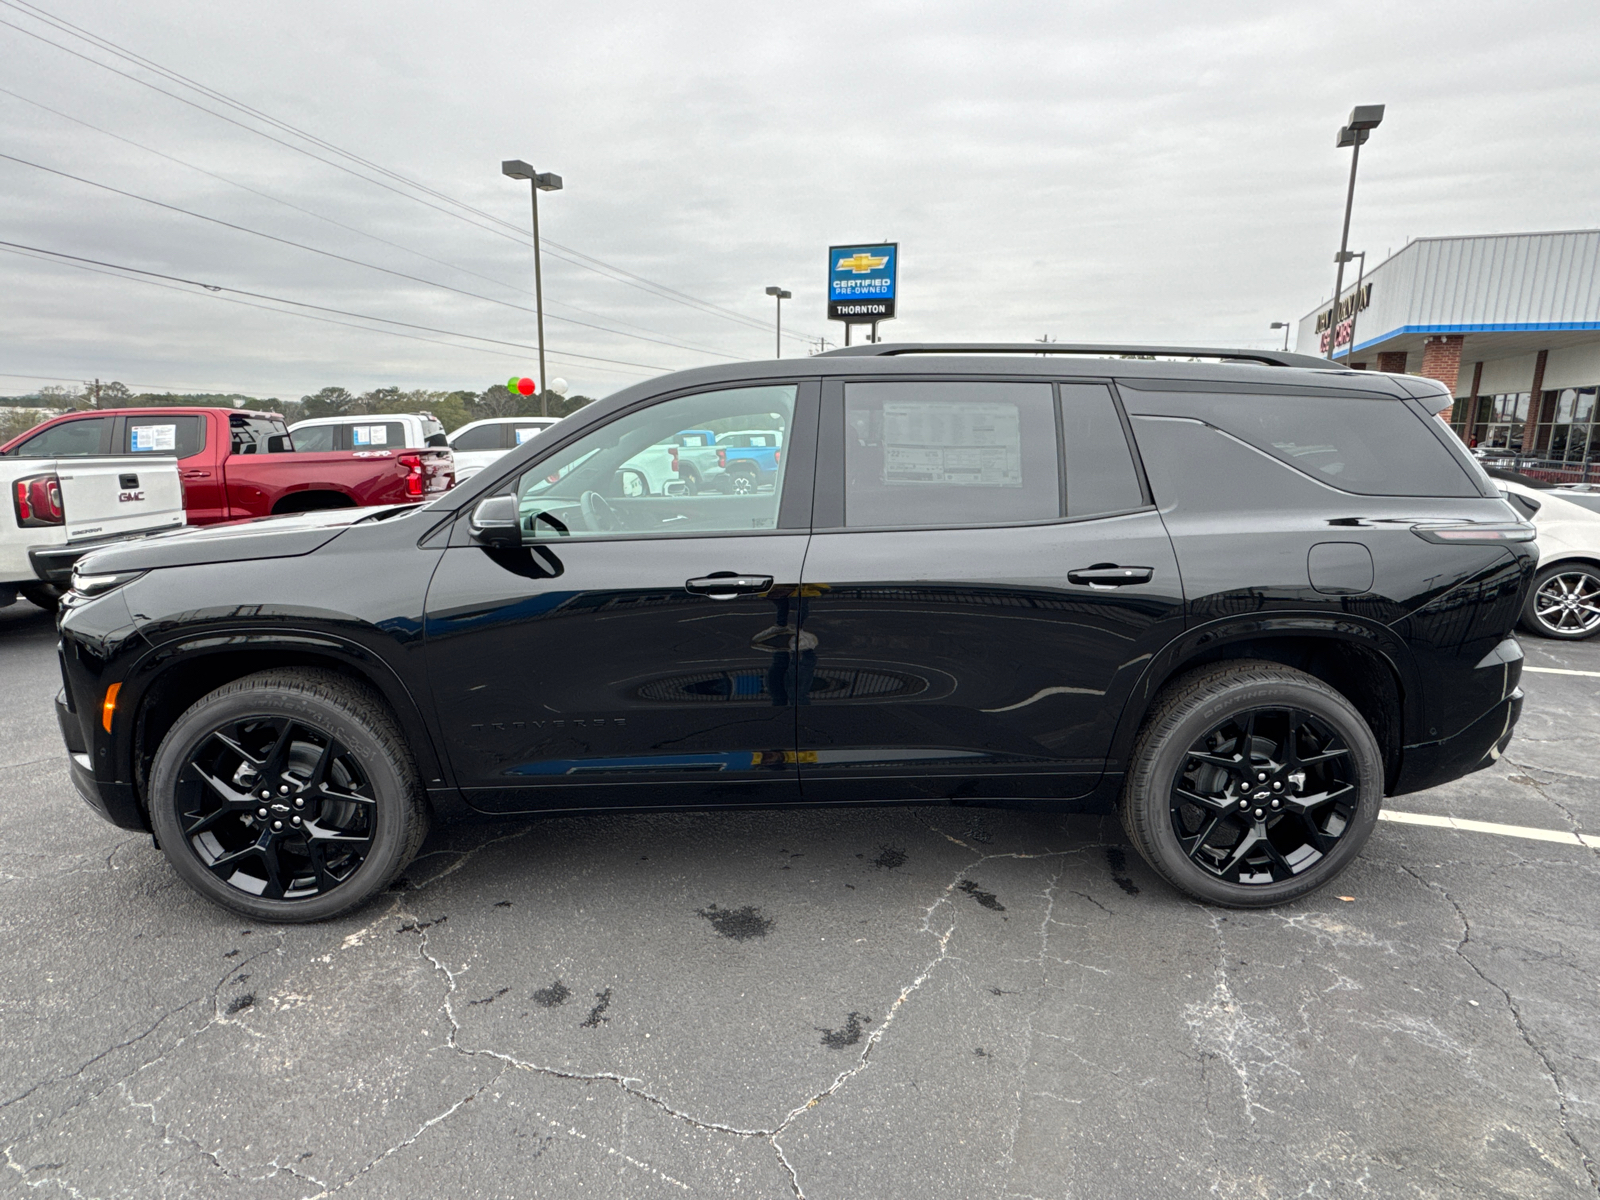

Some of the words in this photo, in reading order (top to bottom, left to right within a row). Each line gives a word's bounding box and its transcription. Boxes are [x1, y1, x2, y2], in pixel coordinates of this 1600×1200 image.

[833, 278, 891, 288] CERTIFIED
[835, 286, 887, 295] PRE-OWNED
[837, 304, 886, 315] THORNTON
[119, 491, 145, 503] GMC
[471, 718, 627, 732] TRAVERSE
